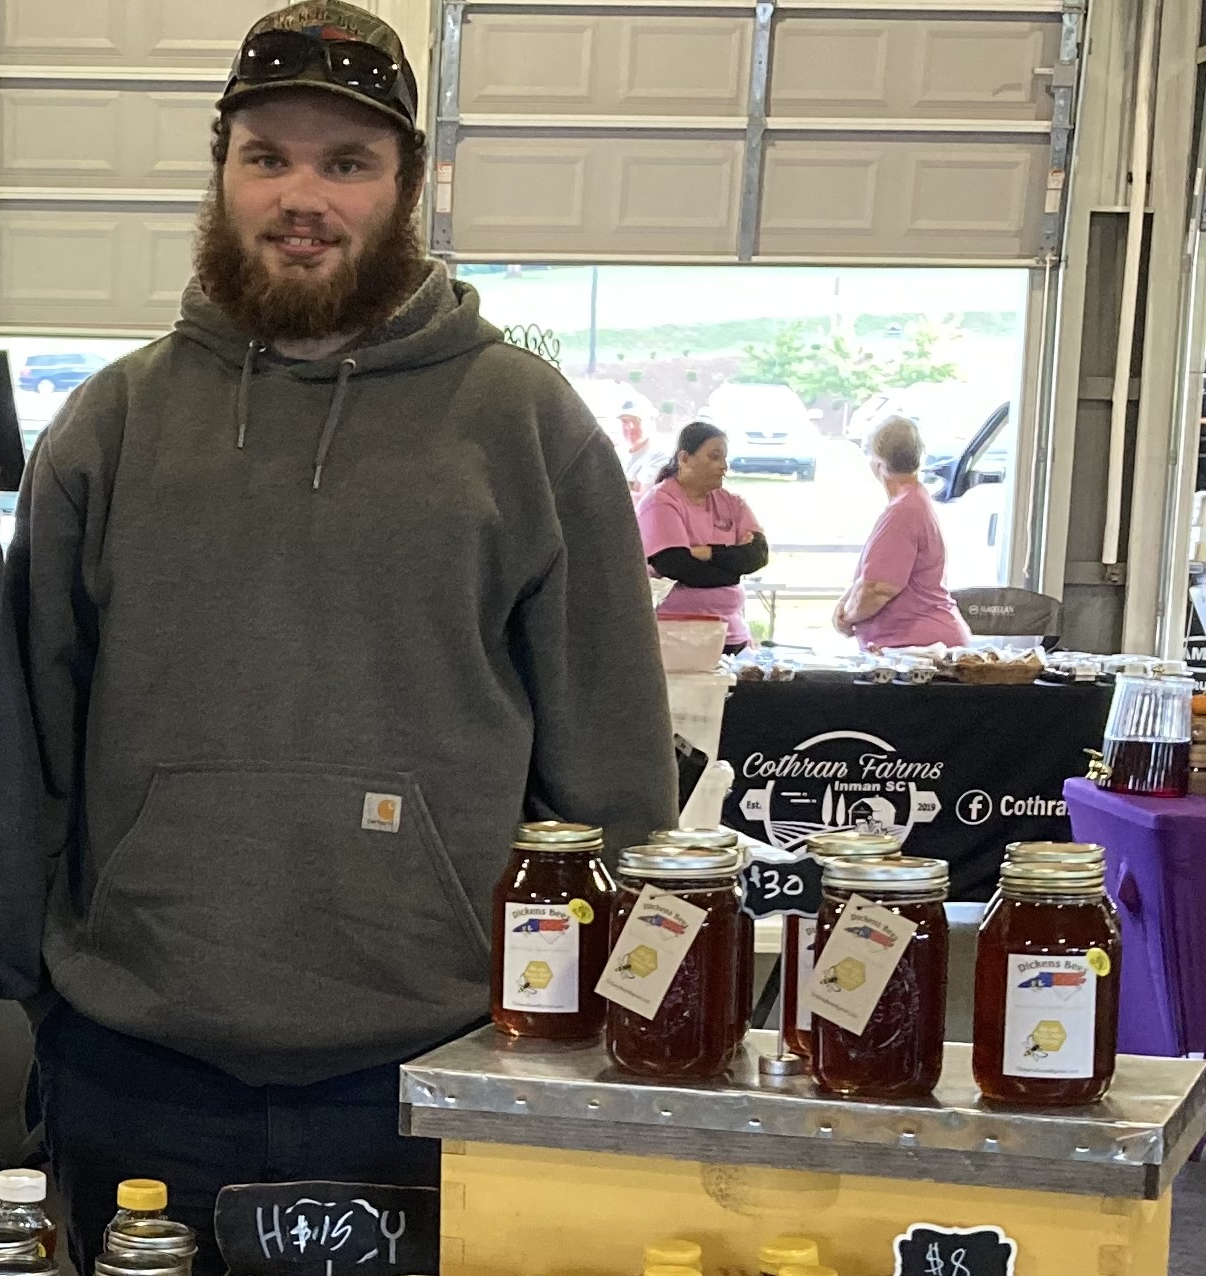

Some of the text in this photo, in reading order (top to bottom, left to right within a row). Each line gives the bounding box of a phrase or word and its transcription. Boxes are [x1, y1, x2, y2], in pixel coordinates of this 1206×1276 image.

[742, 752, 944, 780] Cothran Farms
[833, 780, 906, 793] Inman SC
[746, 800, 763, 810] Est.
[917, 802, 937, 812] 2019
[1000, 795, 1069, 816] Cothra
[749, 865, 804, 900] $30
[1017, 960, 1061, 974] Dickens
